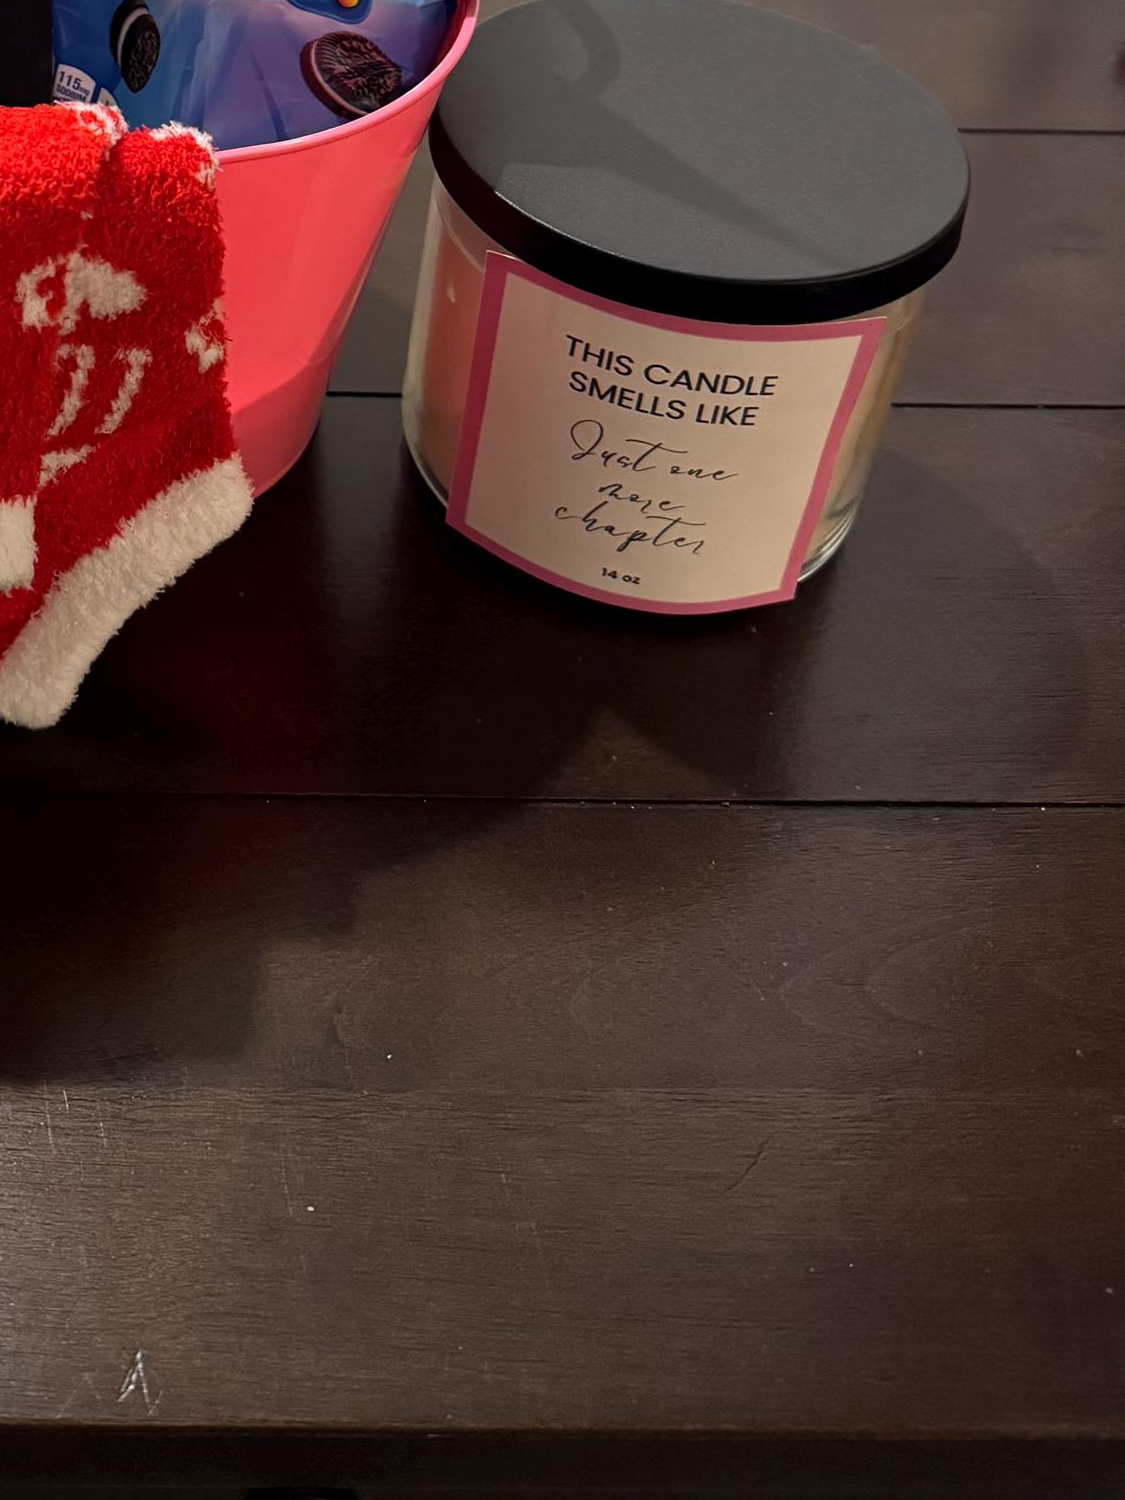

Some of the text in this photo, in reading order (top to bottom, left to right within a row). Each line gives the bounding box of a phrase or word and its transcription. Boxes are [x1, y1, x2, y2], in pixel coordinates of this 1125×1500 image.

[566, 334, 779, 396] THIS CANDLE
[569, 371, 760, 427] SMELLS LIKE
[570, 419, 739, 481] Just one
[598, 483, 686, 514] more
[555, 501, 707, 555] chapter
[601, 566, 618, 580] 14
